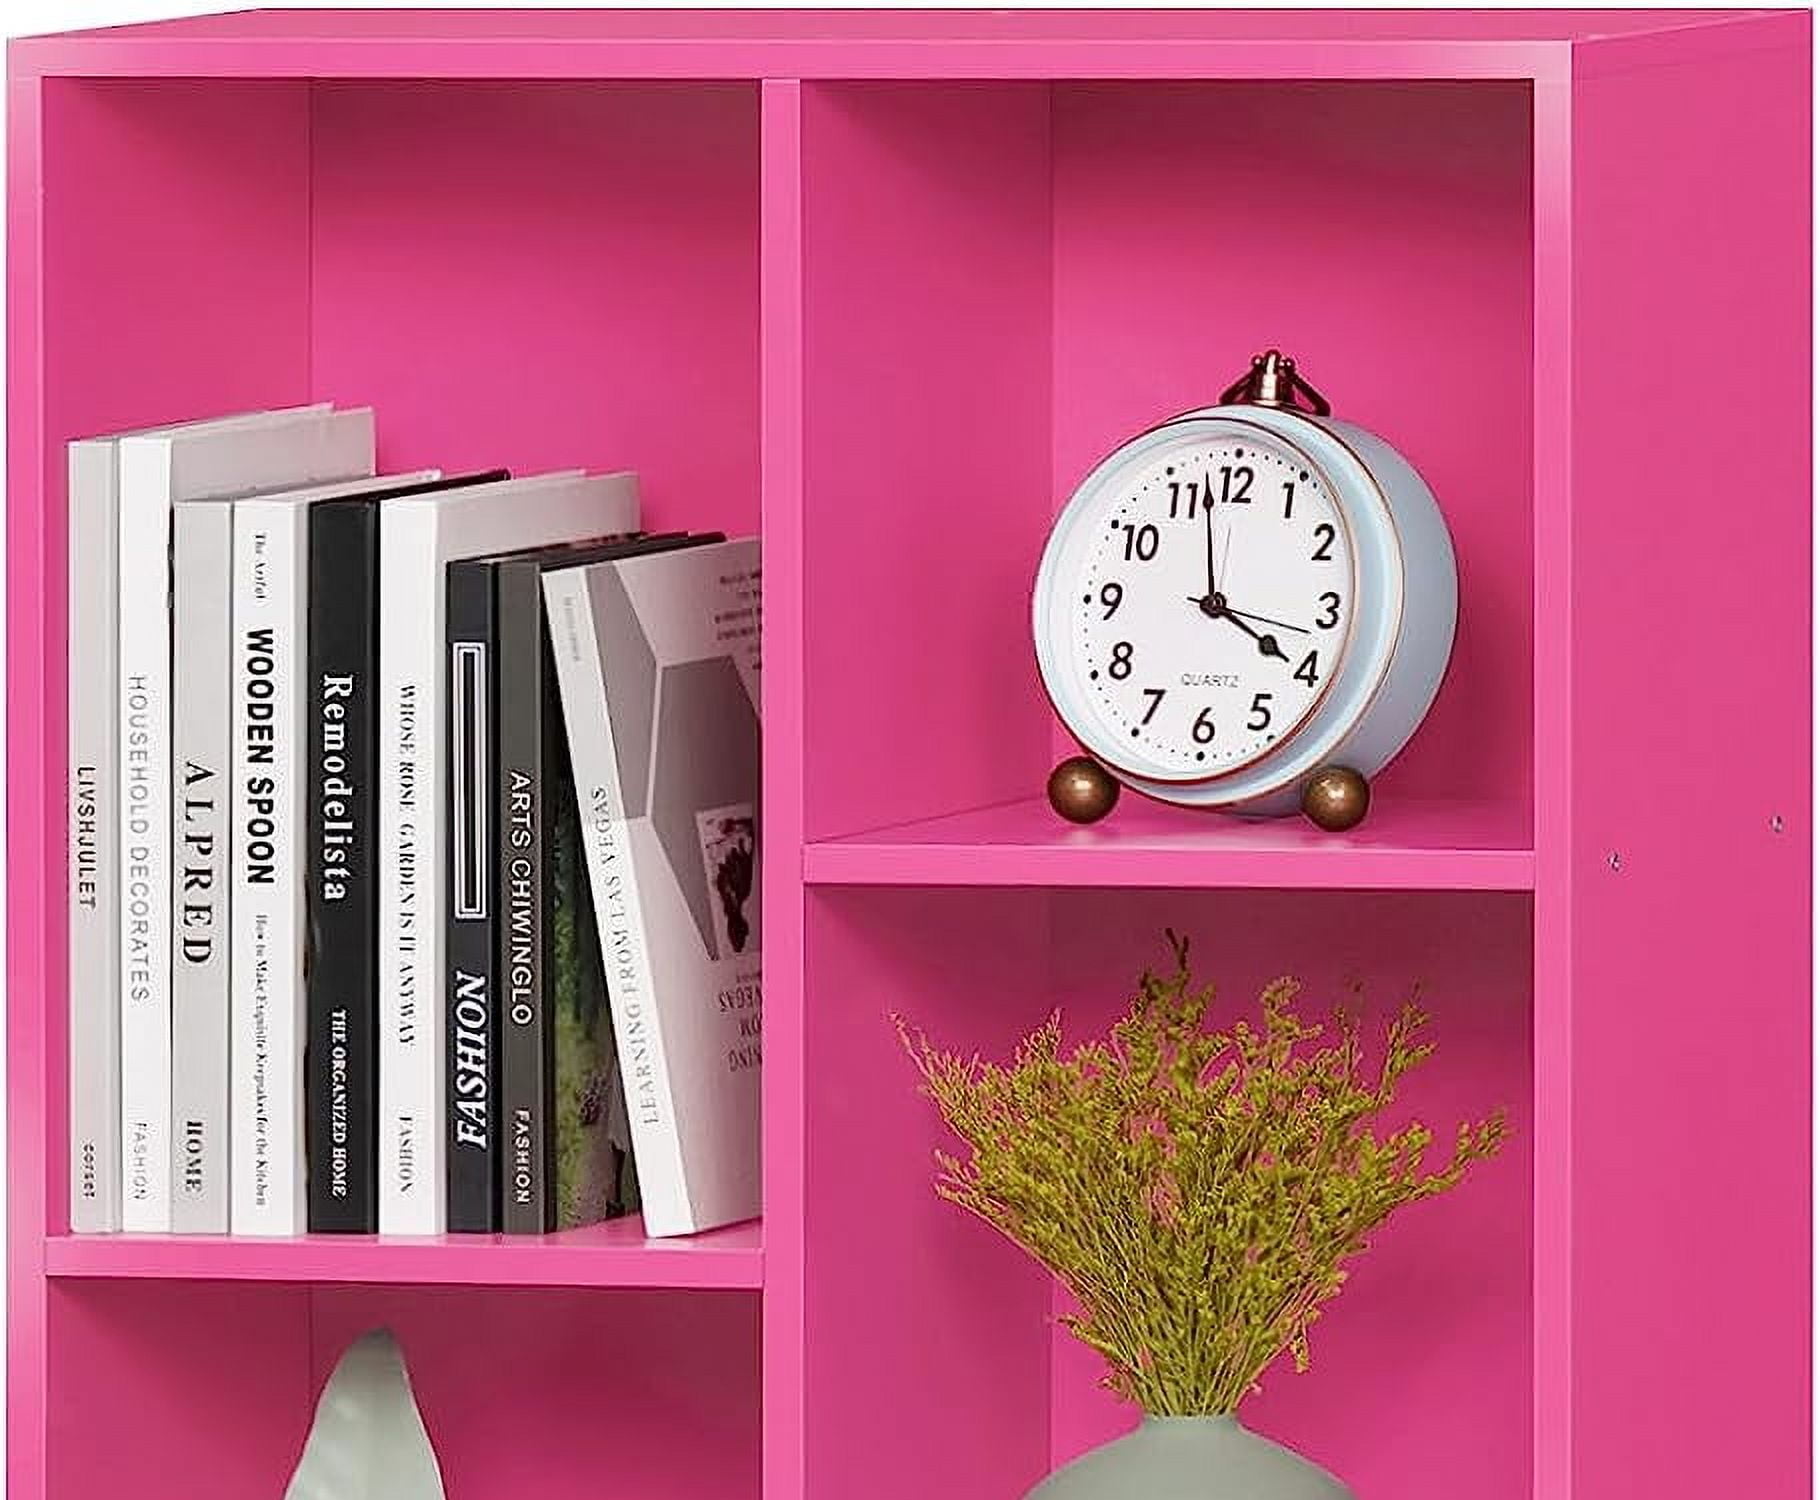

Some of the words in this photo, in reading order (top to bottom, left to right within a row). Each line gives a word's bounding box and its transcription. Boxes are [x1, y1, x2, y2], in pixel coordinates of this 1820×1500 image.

[1168, 482, 1199, 519] 11
[1220, 467, 1254, 503] 12
[1281, 482, 1295, 519] 1
[1122, 524, 1159, 561] 10
[1311, 524, 1335, 561] 2
[1101, 583, 1123, 620] 9
[1315, 592, 1340, 629] 3
[1108, 641, 1133, 679] 8
[1181, 673, 1239, 688] QUARTZ
[1293, 650, 1319, 687] 4
[246, 629, 274, 764] WOODEN
[399, 685, 416, 754] WHOSE
[1142, 689, 1166, 725] 7
[1192, 707, 1215, 743] 6
[1247, 694, 1273, 731] 5
[129, 677, 149, 835] HOUSEHOLD
[323, 674, 353, 900] Remodelista
[399, 762, 416, 812] ROSE
[77, 766, 97, 910] LIVSHJULET
[246, 776, 275, 884] SPOON
[510, 771, 532, 848] ARTS
[591, 785, 617, 864] VEGAS
[182, 762, 216, 964] ALPRED
[399, 823, 416, 905] GARDEN
[605, 875, 625, 916] LAS
[130, 846, 150, 1003] DECORATES
[510, 859, 533, 1026] CHIWINGLO
[612, 929, 638, 992] FROM
[332, 1009, 346, 1043] THE
[398, 961, 416, 1046] ANYWAY
[332, 1047, 346, 1143] ORGANIZED
[457, 971, 487, 1149] FASHION
[623, 1003, 660, 1124] LEARNING
[133, 1122, 148, 1200] FASHION
[185, 1121, 203, 1193] HOME
[332, 1148, 347, 1197] HOME
[398, 1118, 417, 1193] FASHION
[516, 1109, 531, 1204] FASHION
